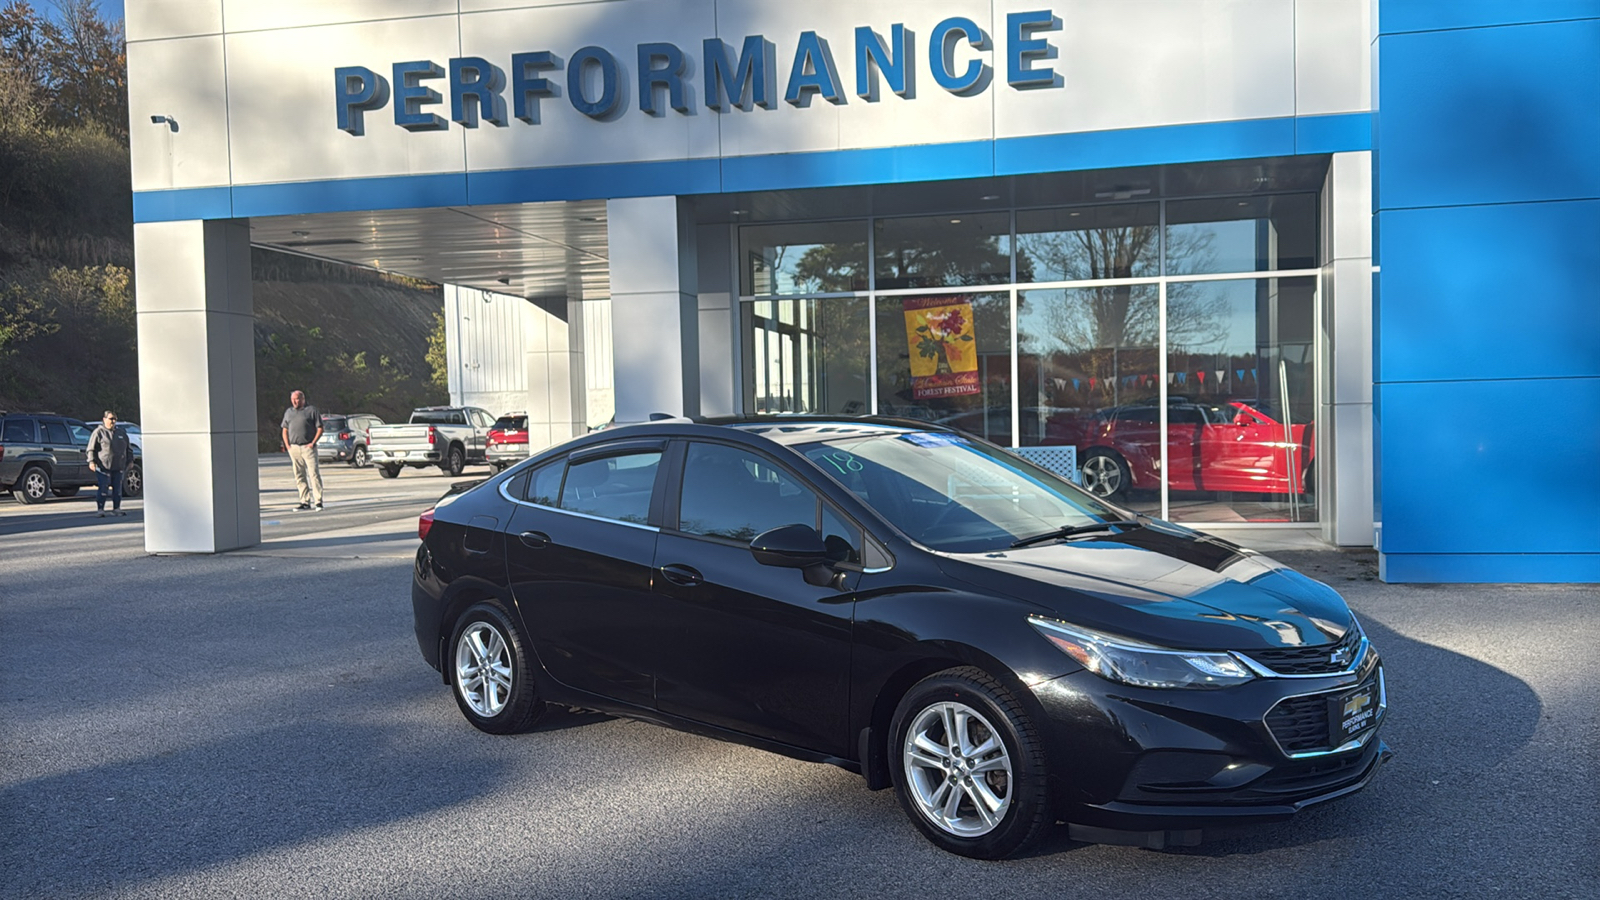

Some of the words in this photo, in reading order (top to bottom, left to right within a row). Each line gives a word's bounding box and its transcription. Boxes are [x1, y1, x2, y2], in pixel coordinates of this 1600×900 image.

[335, 10, 1062, 136] PERFORMANCE
[917, 387, 943, 397] FOREST
[943, 384, 977, 395] FESTIVAL
[822, 452, 864, 475] 18
[1342, 708, 1373, 730] PERFORMANCE
